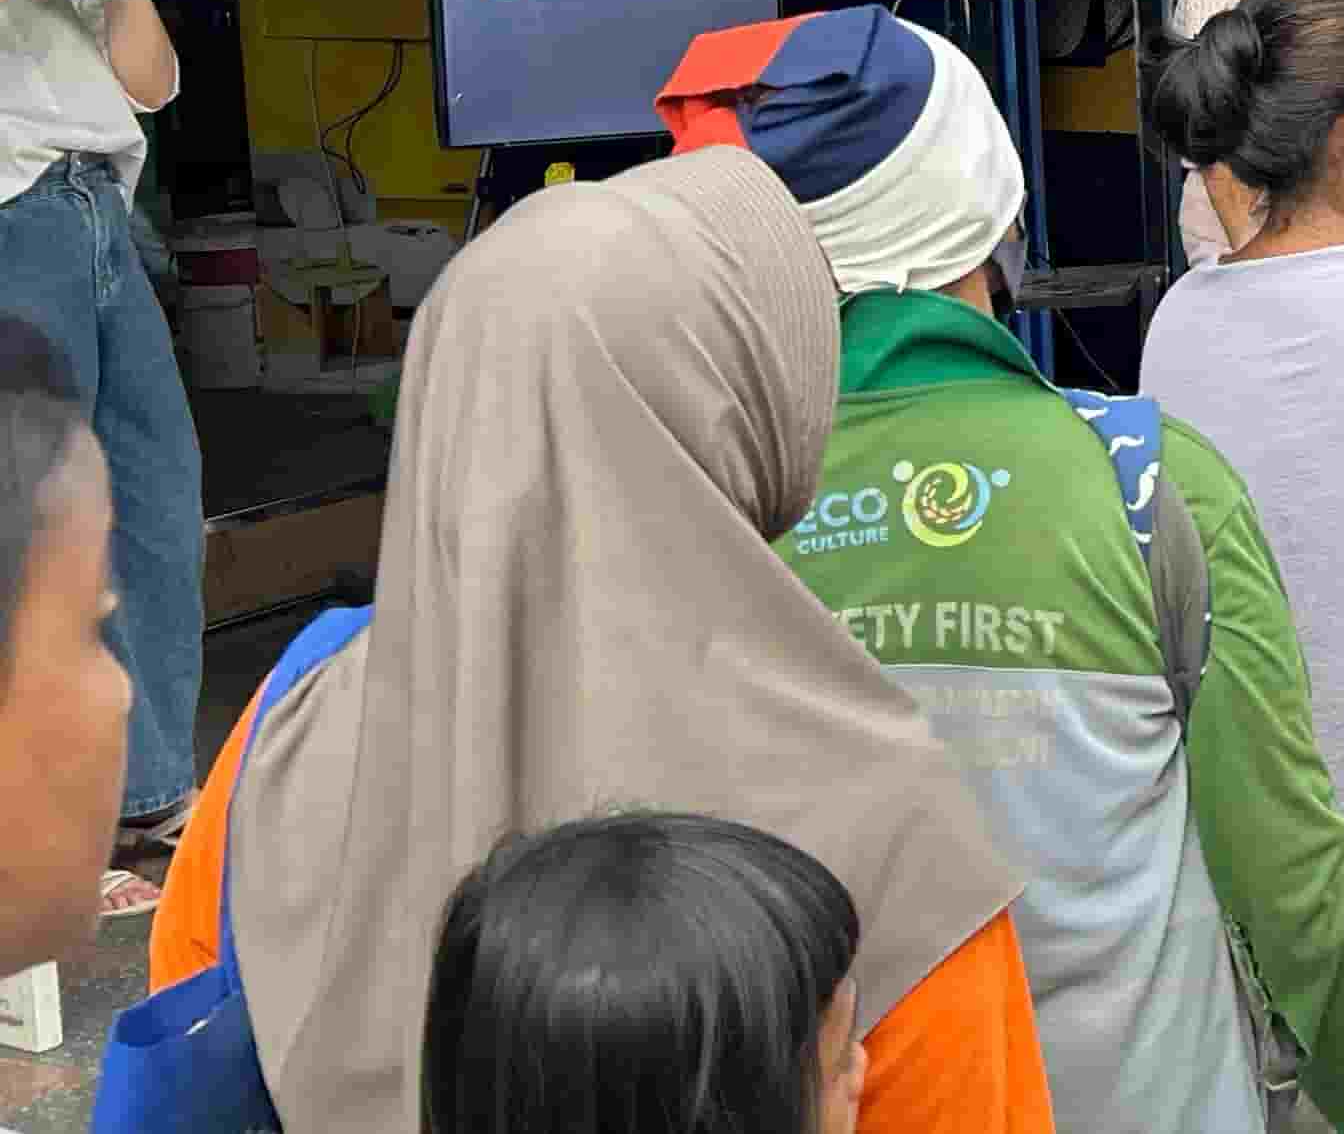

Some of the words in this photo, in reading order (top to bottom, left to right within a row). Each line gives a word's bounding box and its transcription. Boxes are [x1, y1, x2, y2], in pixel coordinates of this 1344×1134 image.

[797, 526, 888, 555] CULTURE
[833, 603, 921, 650] ETY
[935, 601, 1064, 655] FIRST
